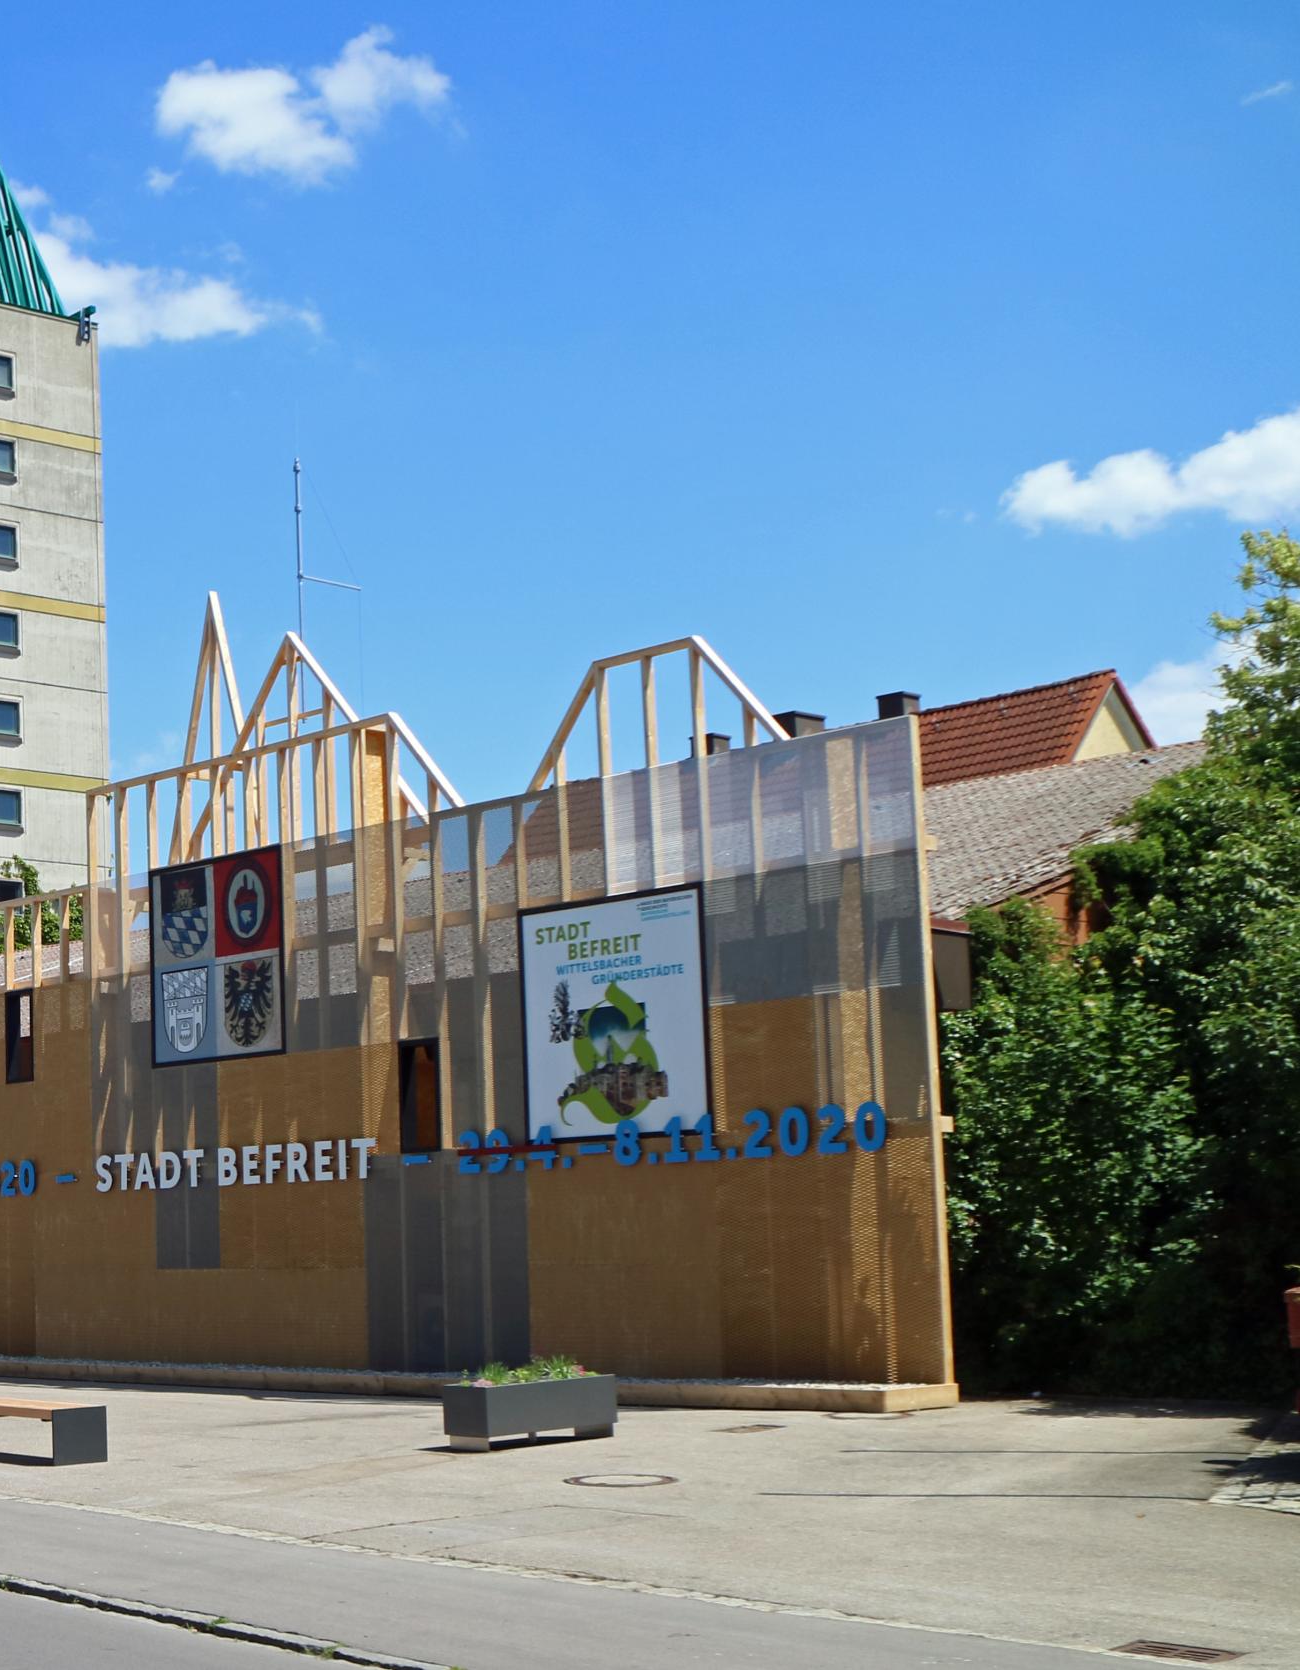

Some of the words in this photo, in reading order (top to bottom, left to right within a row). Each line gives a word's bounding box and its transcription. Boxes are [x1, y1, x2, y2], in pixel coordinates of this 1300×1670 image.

[535, 921, 591, 945] STADT
[568, 934, 641, 960] BEFREIT
[556, 955, 642, 976] WITTELSBACHER
[591, 963, 685, 985] GRÜNDERSTÄDTE
[95, 1148, 204, 1193] STADT
[217, 1137, 378, 1187] BEFREIT
